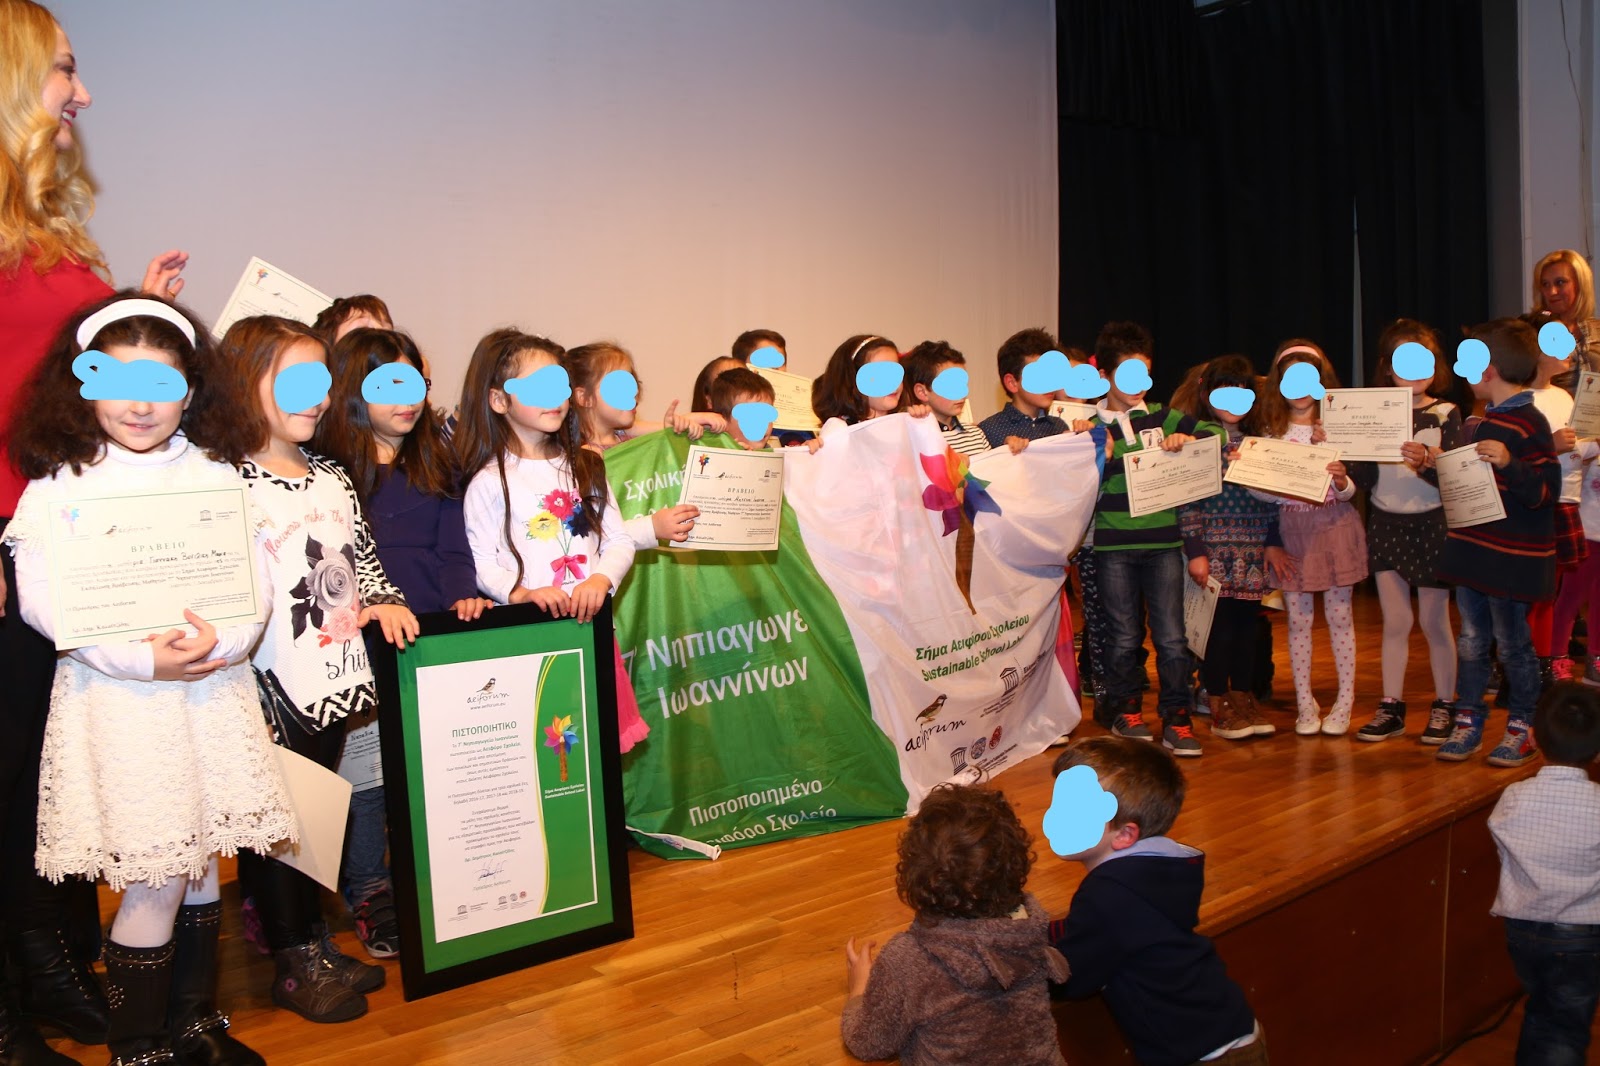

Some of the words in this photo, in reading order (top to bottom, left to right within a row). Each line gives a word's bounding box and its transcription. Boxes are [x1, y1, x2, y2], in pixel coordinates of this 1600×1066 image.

[131, 541, 185, 553] ΒΡΑΒΕΙΟ
[646, 609, 809, 671] Νηπιαγωγε
[916, 645, 948, 661] Σήμα
[990, 614, 1030, 639] Σχολείου
[921, 655, 980, 682] Sustainable
[467, 692, 510, 704] aeiforum
[658, 657, 808, 719] Ιωαννίνων
[452, 720, 517, 738] ΠΙΣΤΟΠΟΙΗΤΙΚΟ
[689, 778, 823, 827] Πιστοποιημένο
[766, 805, 837, 832] Σχολείο
